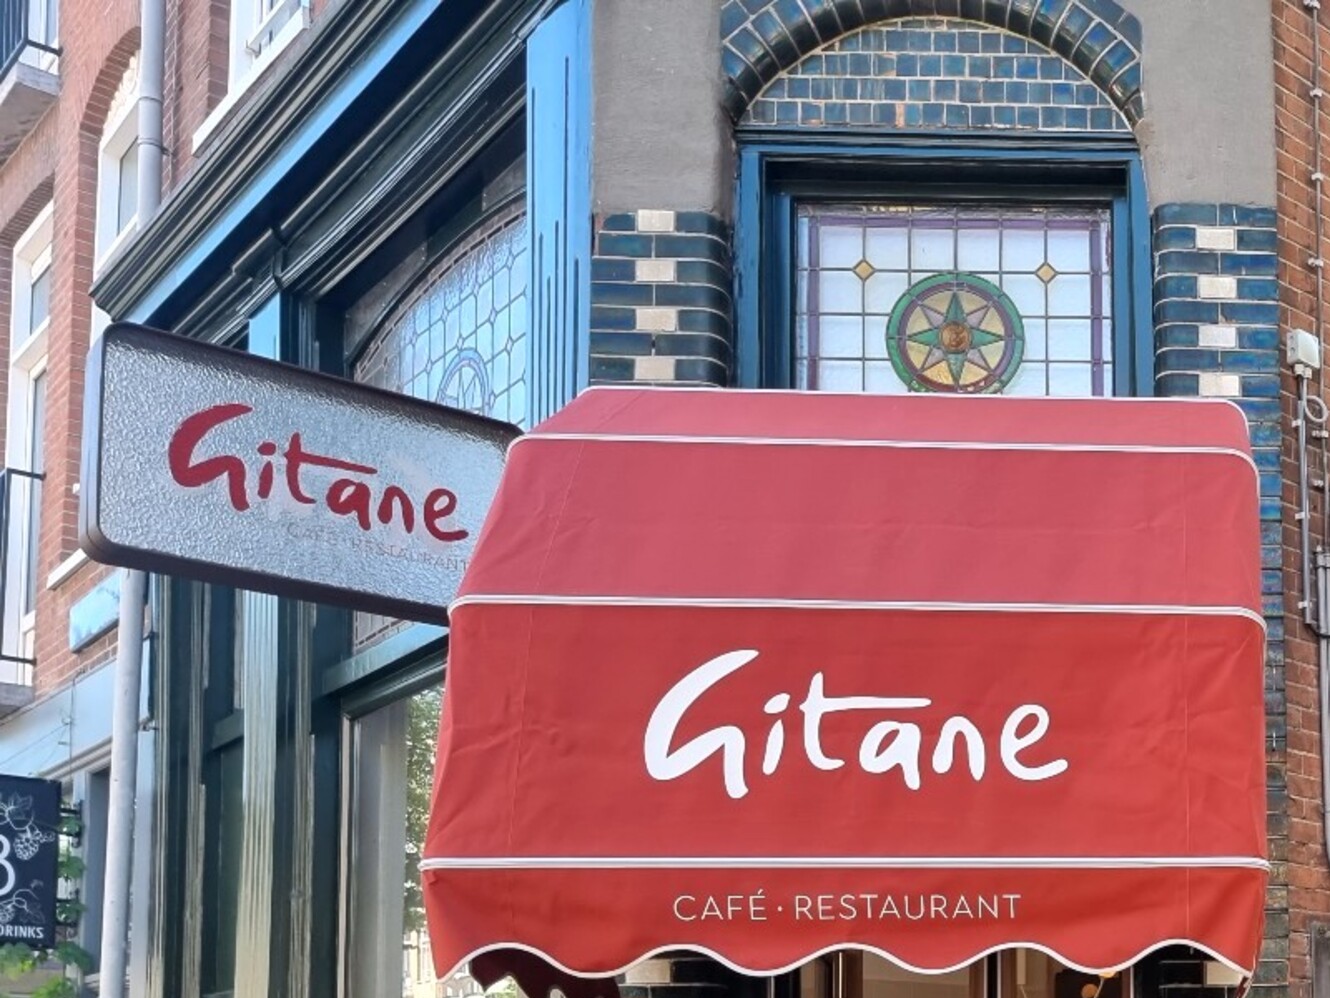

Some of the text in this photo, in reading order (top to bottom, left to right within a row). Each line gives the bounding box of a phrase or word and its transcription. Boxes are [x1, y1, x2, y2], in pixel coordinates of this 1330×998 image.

[168, 403, 469, 542] Gitane
[644, 649, 1068, 799] Gitane
[673, 889, 1022, 923] CAFÉ RESTAURANT
